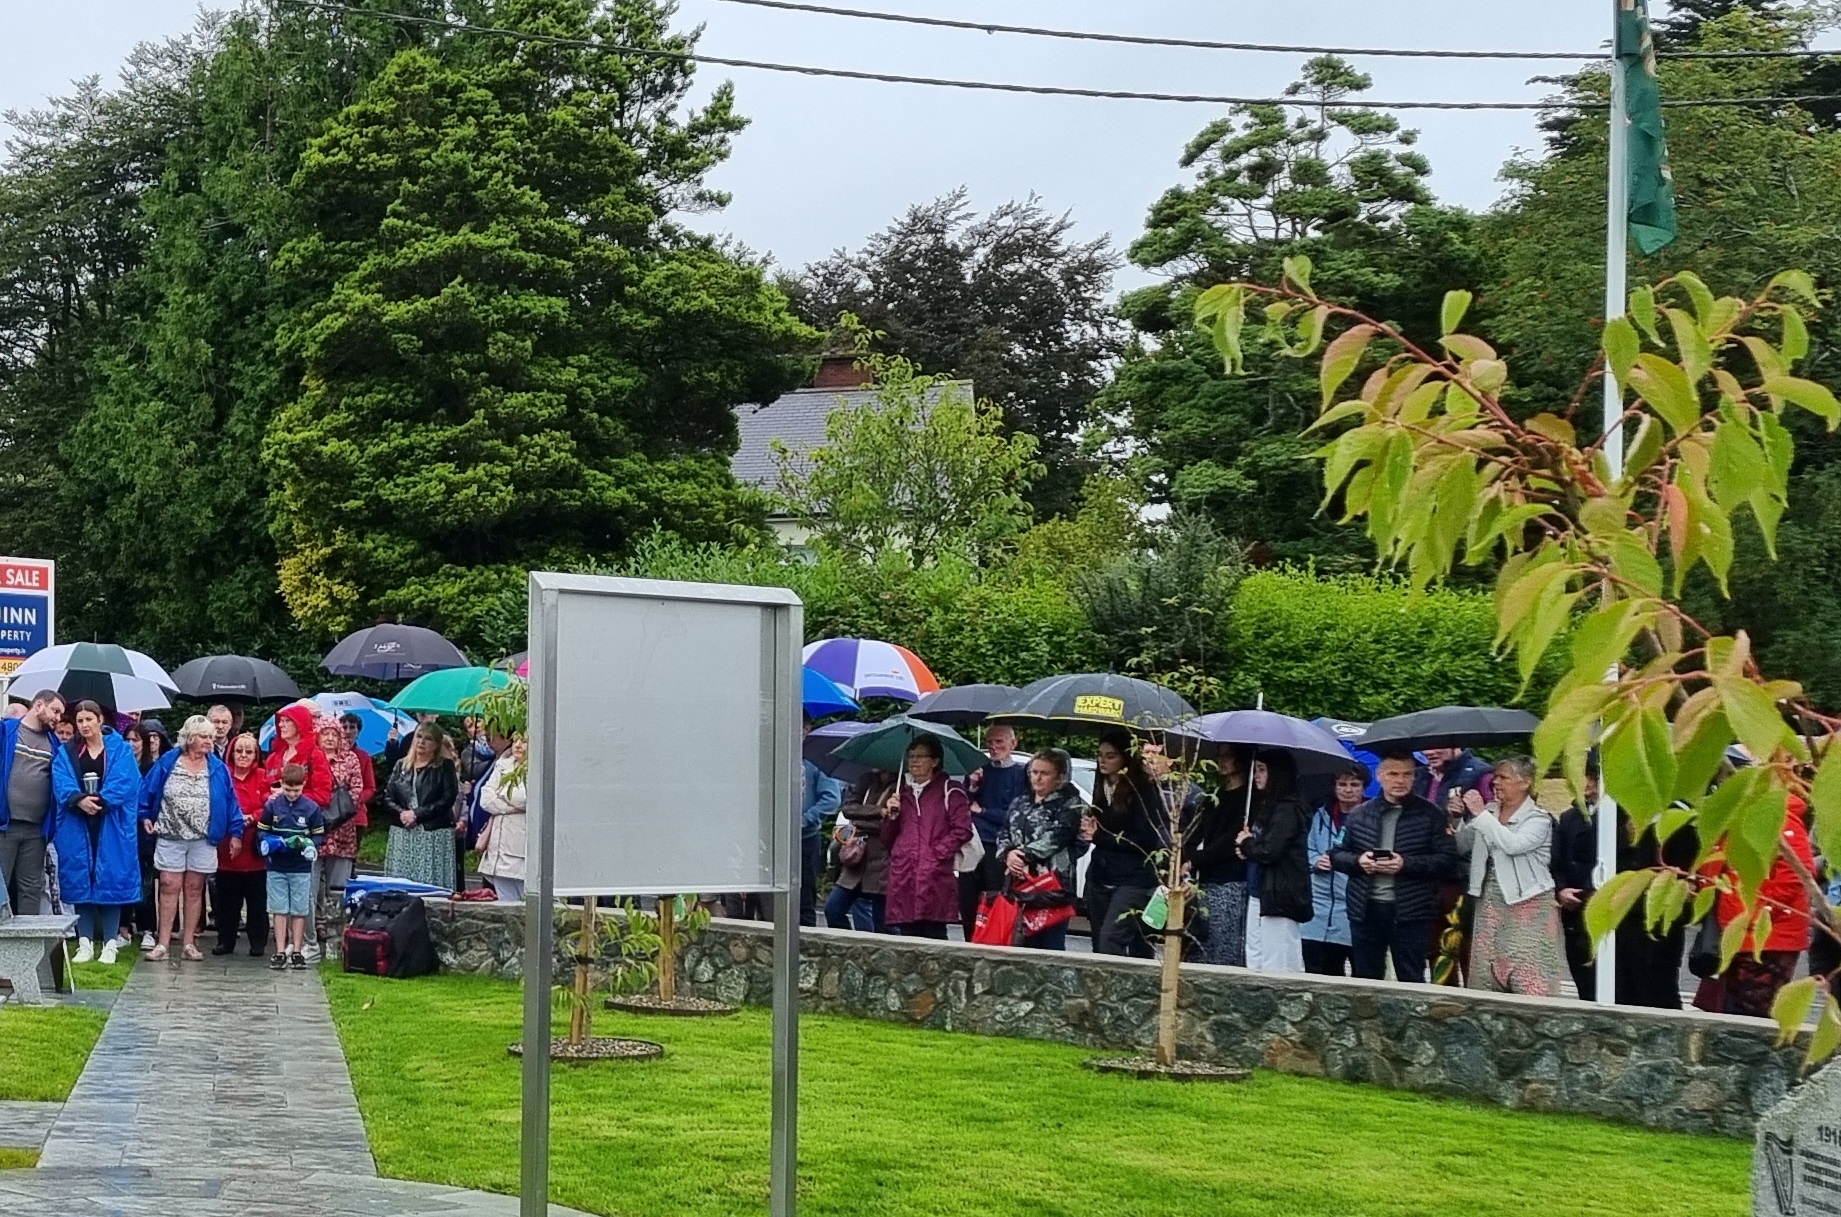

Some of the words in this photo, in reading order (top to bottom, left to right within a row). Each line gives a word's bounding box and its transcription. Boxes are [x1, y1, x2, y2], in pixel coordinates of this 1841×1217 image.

[5, 568, 40, 587] SALE
[1078, 697, 1121, 710] EXPERT
[1817, 1125, 1841, 1147] 191
